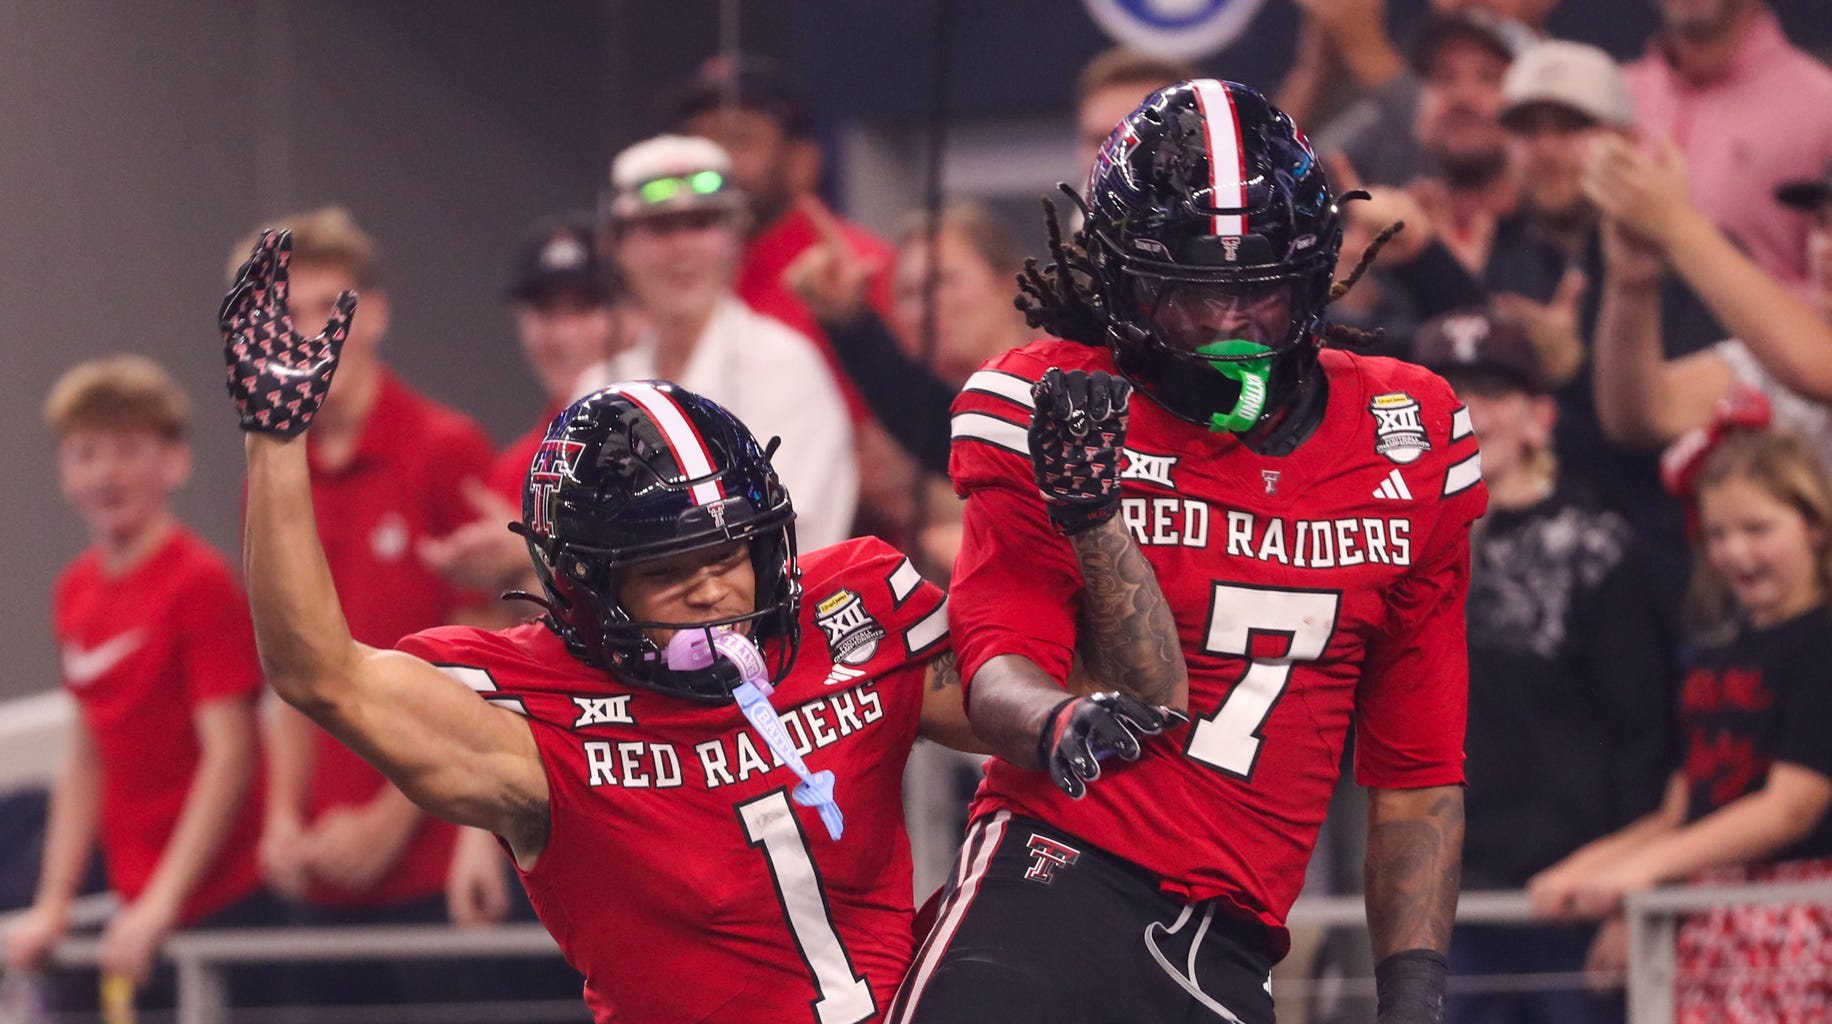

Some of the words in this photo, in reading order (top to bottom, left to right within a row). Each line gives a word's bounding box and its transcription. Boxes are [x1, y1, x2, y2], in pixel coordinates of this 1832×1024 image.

[1371, 404, 1425, 435] XII
[1120, 448, 1178, 488] XII
[1121, 499, 1209, 548] RED
[1226, 510, 1411, 569] RAIDERS
[818, 597, 873, 647] XII
[1184, 580, 1342, 781] 7
[573, 695, 634, 727] XII
[583, 740, 684, 788] RED
